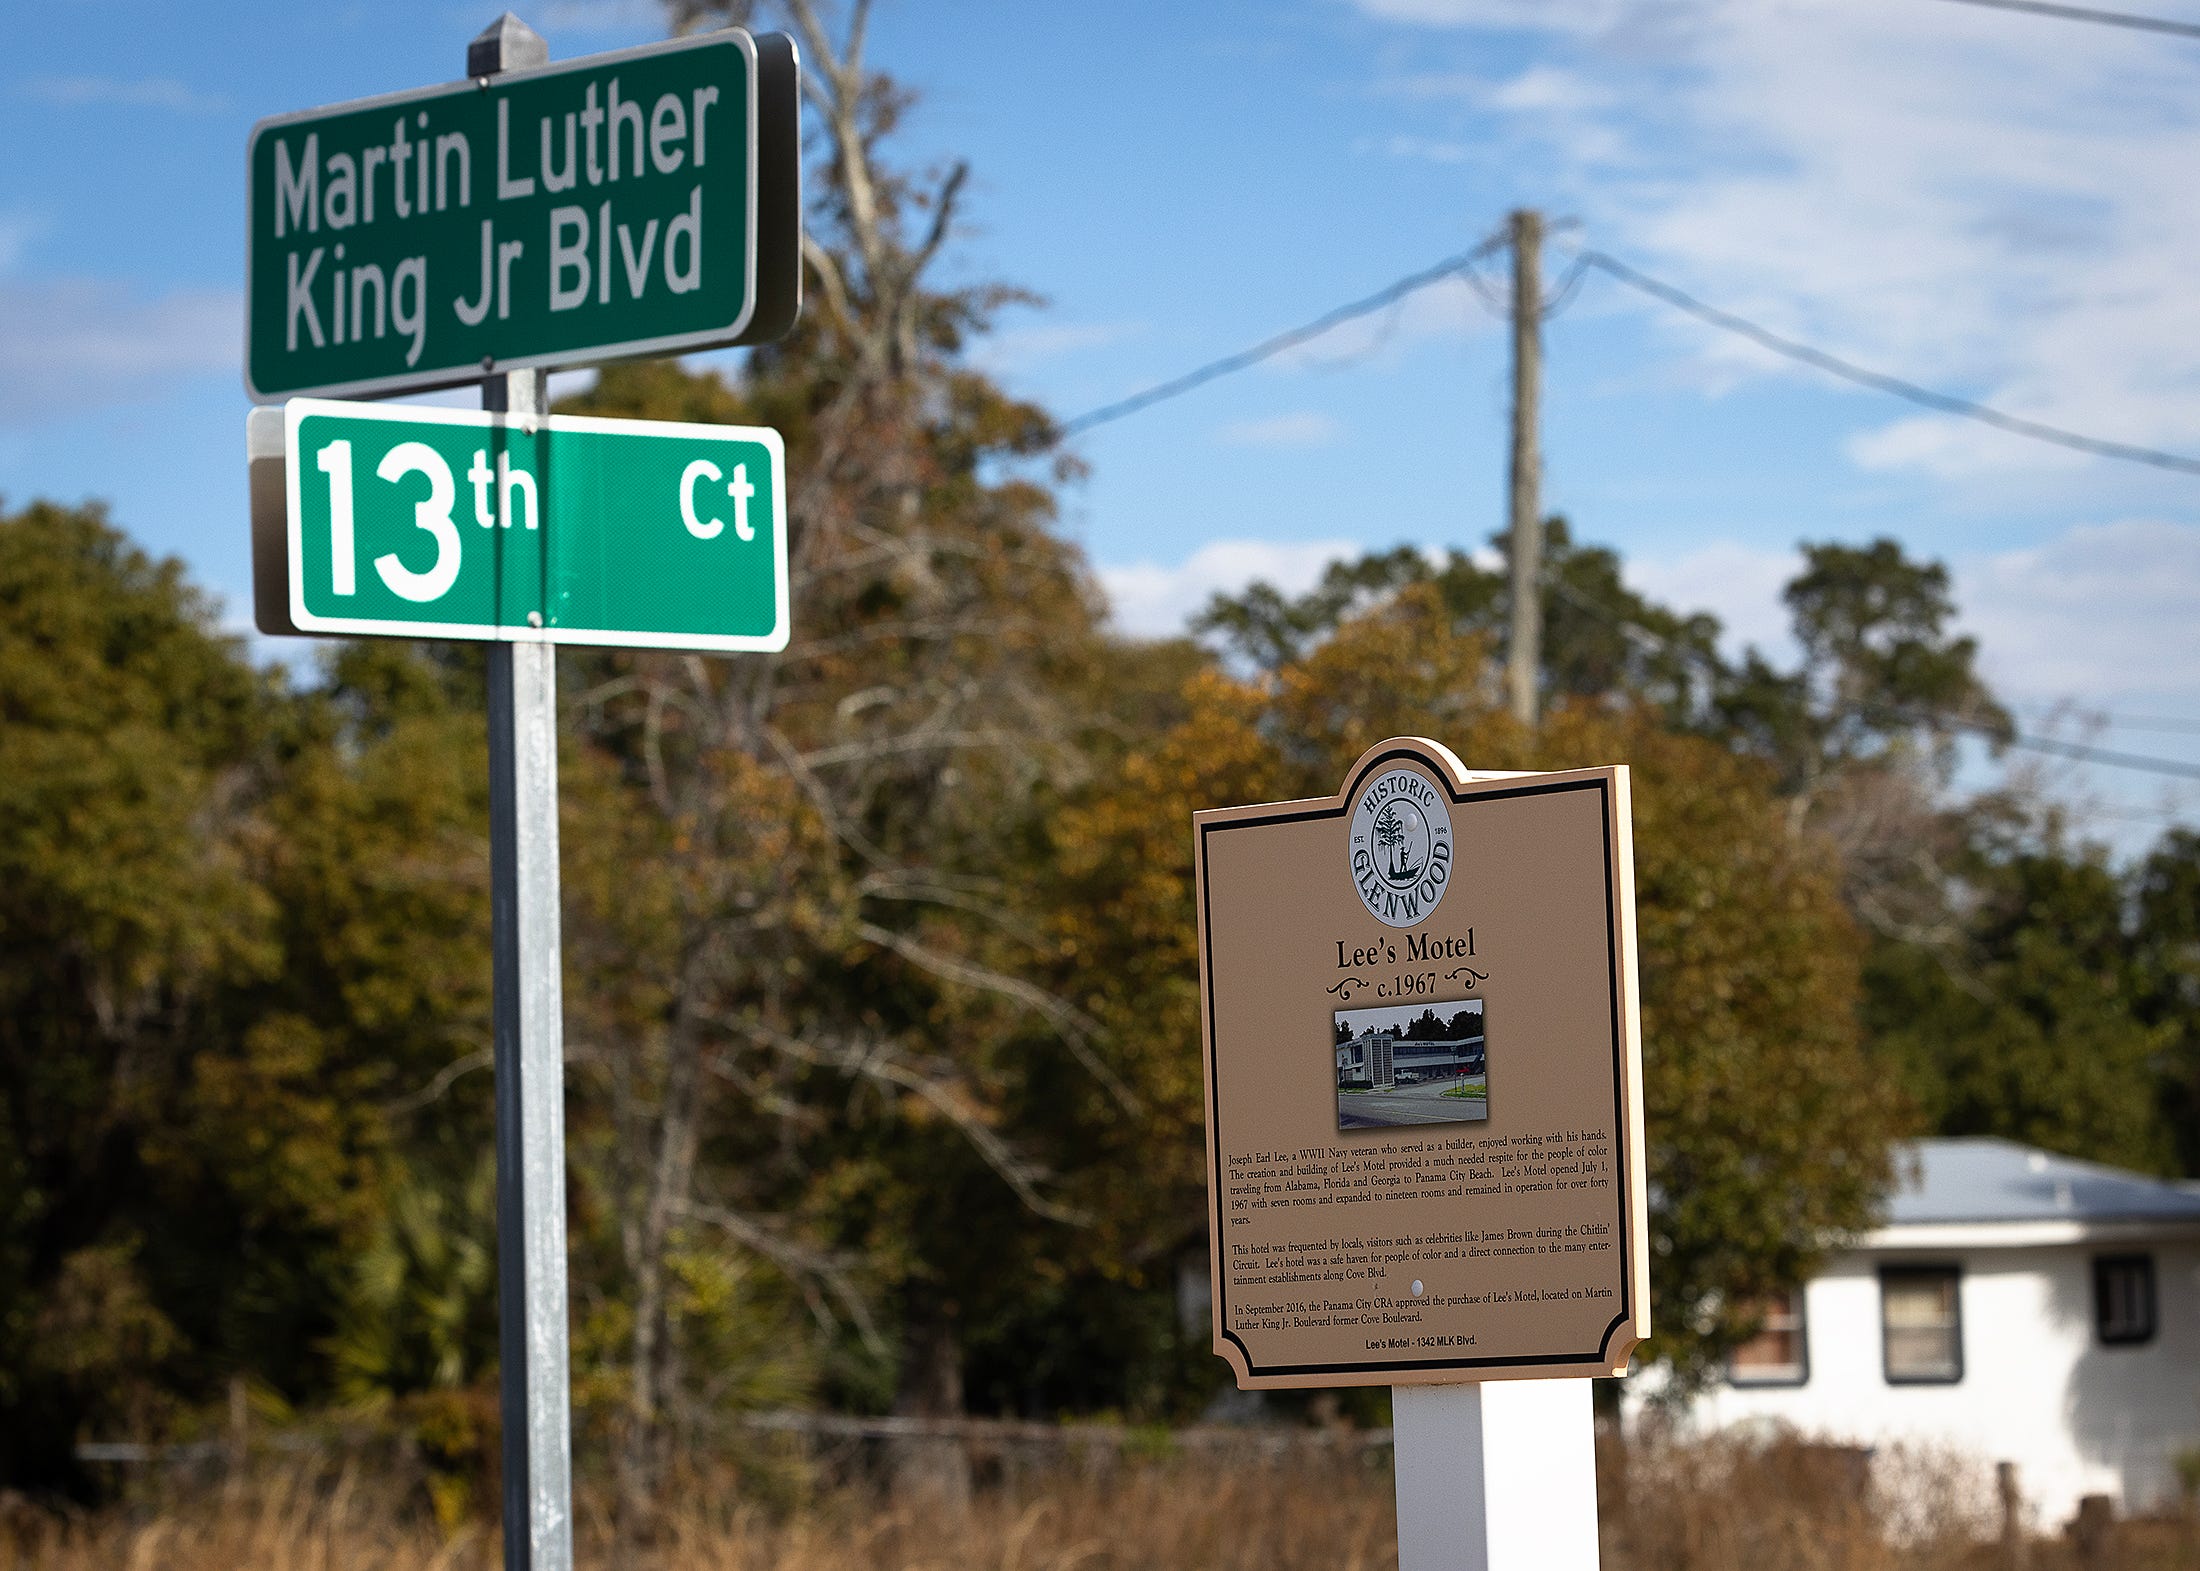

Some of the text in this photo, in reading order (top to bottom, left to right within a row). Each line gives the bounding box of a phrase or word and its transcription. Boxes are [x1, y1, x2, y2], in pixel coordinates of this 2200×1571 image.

[273, 77, 720, 239] Martin Luther
[285, 185, 702, 368] King Jr Blvd
[316, 438, 756, 604] 13th Ct
[1363, 775, 1435, 815] HISTORIC
[1434, 826, 1448, 835] 1896
[1353, 839, 1450, 920] GLENWOOD
[1335, 927, 1477, 969] Lee's Motel
[1377, 972, 1436, 998] c.1967
[1228, 1153, 1252, 1167] Joseph
[1256, 1152, 1271, 1163] Earl
[1274, 1151, 1289, 1163] Lee,
[1299, 1148, 1325, 1160] WWII
[1328, 1147, 1348, 1159] Navy
[1350, 1148, 1378, 1156] veteran
[1381, 1143, 1397, 1154] who
[1401, 1141, 1423, 1153] served
[1446, 1138, 1475, 1150] builder,
[1478, 1135, 1508, 1150] enjoyed
[1511, 1134, 1543, 1146] working
[1545, 1131, 1563, 1143] with
[1566, 1131, 1578, 1142] his
[1581, 1129, 1607, 1141] hands.
[1229, 1169, 1244, 1180] The
[1247, 1168, 1276, 1179] creation
[1279, 1165, 1293, 1177] and
[1297, 1164, 1328, 1176] building
[1330, 1162, 1339, 1173] of
[1341, 1161, 1360, 1172] Lee's
[1363, 1159, 1385, 1171] Motel
[1389, 1157, 1422, 1170] provided
[1433, 1154, 1455, 1166] much
[1458, 1152, 1485, 1165] needed
[1488, 1151, 1513, 1164] respite
[1517, 1150, 1528, 1161] for
[1531, 1149, 1544, 1160] the
[1547, 1147, 1573, 1161] people
[1576, 1145, 1585, 1157] of
[1588, 1146, 1608, 1156] color
[1230, 1161, 1608, 1196] traveling from Alabama, Florida and Georgia to Panama City Beach. Lee's Motel opened July 1,
[1231, 1176, 1609, 1210] 1967 with seven rooms and expanded to nineteen rooms and remained in operation for over forty
[1231, 1217, 1251, 1227] years.
[1232, 1223, 1610, 1255] This hotel was frequented by locals, visitors such as celebrities like James Brown during the Chitlin'
[1233, 1259, 1260, 1270] Circuit.
[1265, 1257, 1283, 1268] Lee's
[1285, 1256, 1304, 1267] hotel
[1307, 1258, 1321, 1266] was
[1330, 1253, 1344, 1265] safe
[1346, 1253, 1368, 1264] haven
[1371, 1251, 1382, 1263] for
[1385, 1250, 1410, 1264] people
[1412, 1249, 1420, 1260] of
[1422, 1248, 1442, 1260] color
[1444, 1247, 1459, 1259] and
[1462, 1250, 1466, 1258] a
[1469, 1246, 1491, 1257] direct
[1493, 1244, 1535, 1256] connection
[1538, 1245, 1546, 1254] to
[1549, 1242, 1562, 1253] the
[1564, 1244, 1586, 1253] many
[1588, 1242, 1611, 1251] enter-
[1233, 1267, 1387, 1285] tainment establishments along Cove Blvd.
[1234, 1287, 1613, 1316] In September 2016, the Panama City CRA approved the purchase of Lee's Motel, located on Martin
[1235, 1311, 1422, 1331] Luther King Jr. Boulevard former Cove Boulevard.
[1366, 1339, 1386, 1349] Lee's
[1388, 1338, 1410, 1348] Motel
[1417, 1337, 1435, 1347] 1342
[1437, 1336, 1455, 1346] MLK
[1457, 1334, 1477, 1345] Blvd.
